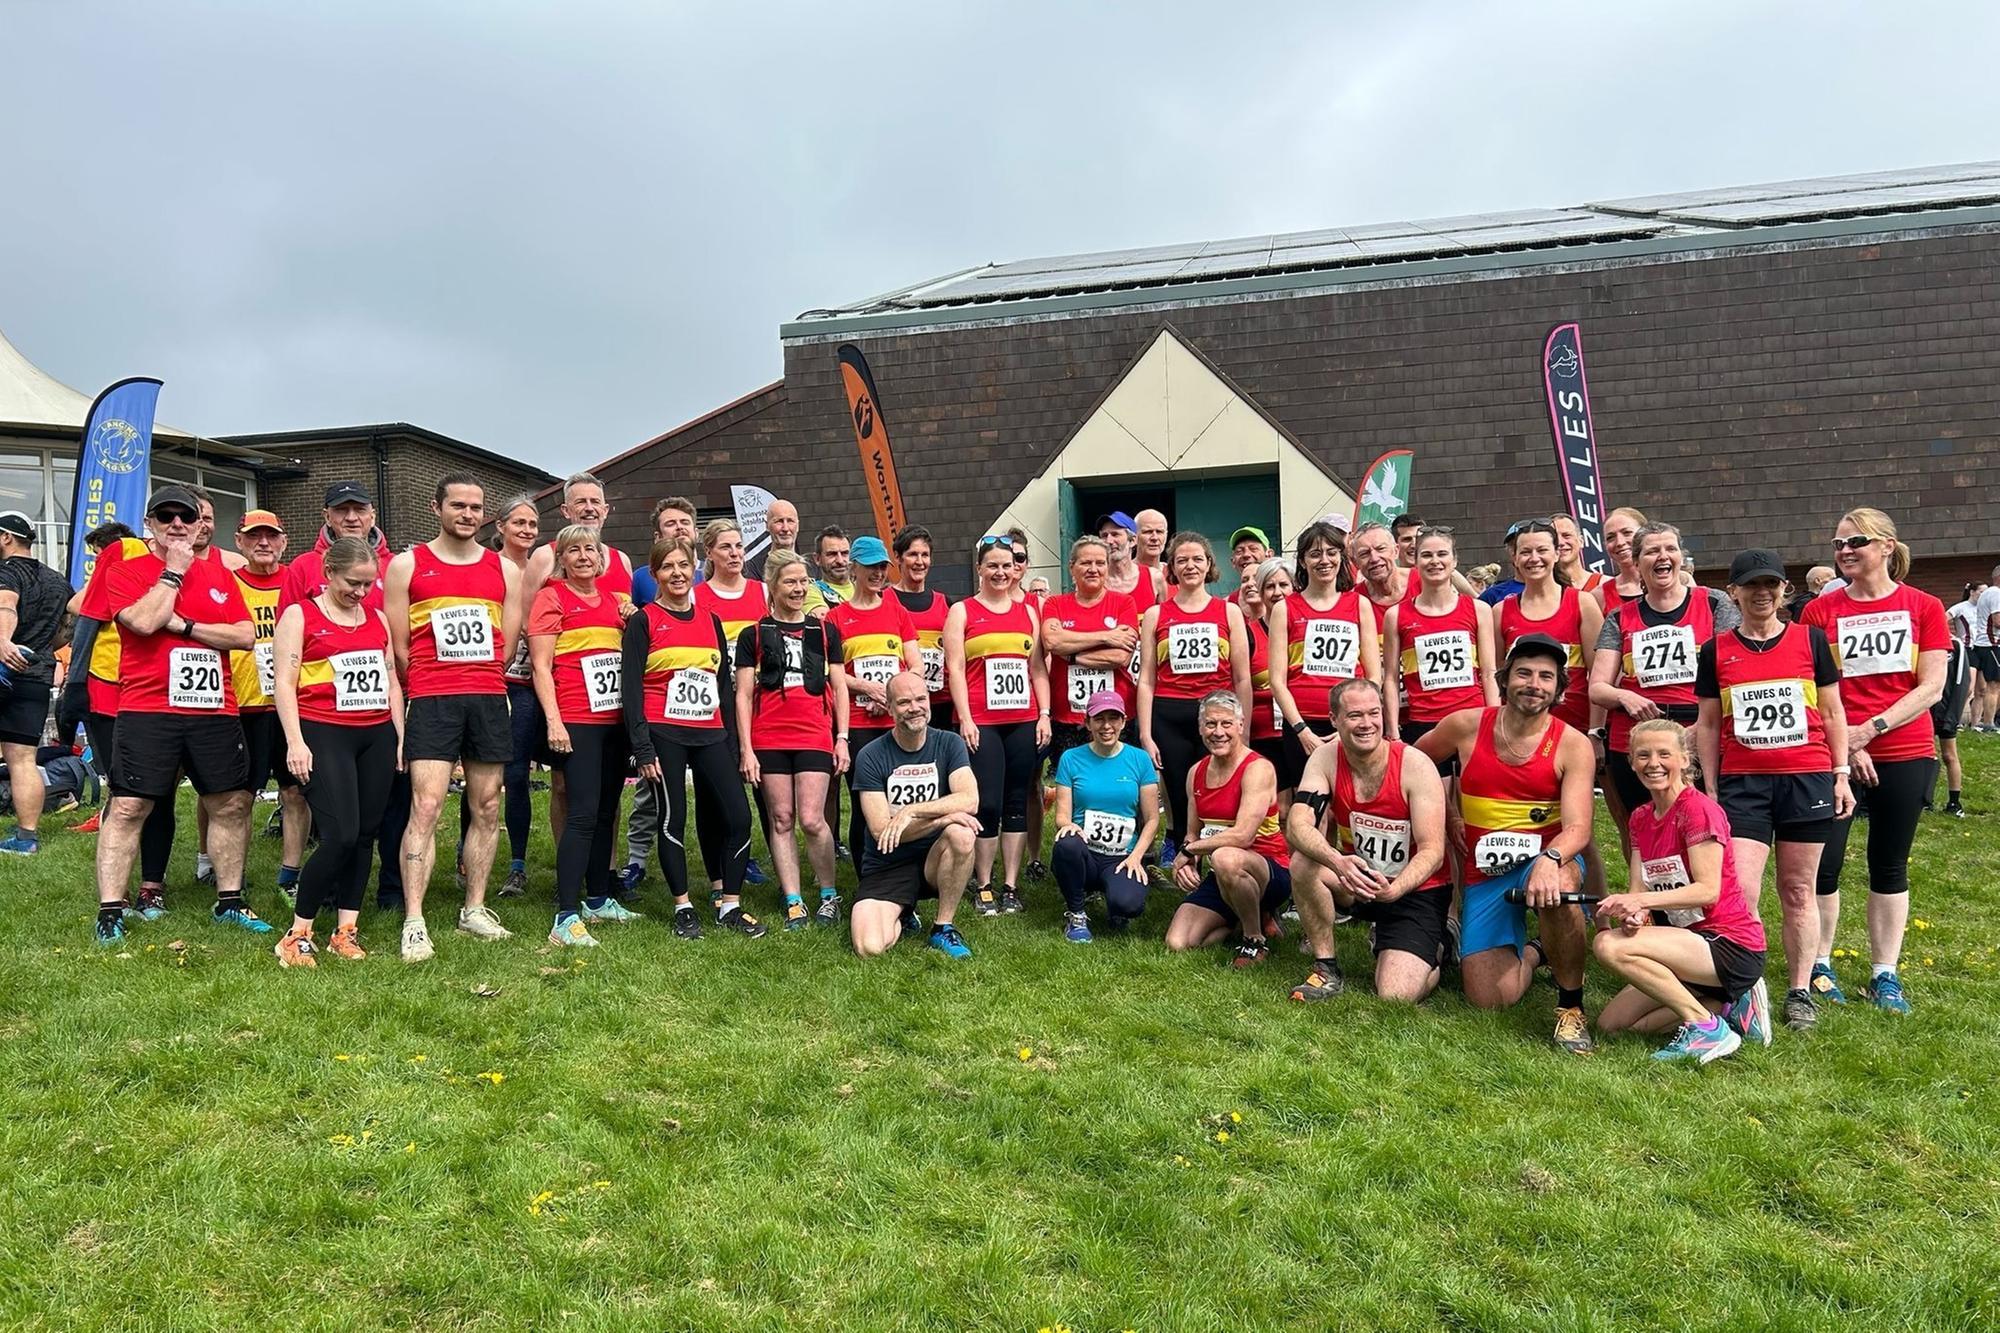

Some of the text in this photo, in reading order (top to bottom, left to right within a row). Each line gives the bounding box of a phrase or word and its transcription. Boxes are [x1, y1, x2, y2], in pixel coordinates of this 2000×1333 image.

[84, 478, 103, 557] EGLES
[440, 608, 480, 620] LEWES AC
[443, 620, 486, 646] 303
[1176, 626, 1211, 636] LEWES AC
[1315, 623, 1352, 635] LEWES AC
[1424, 635, 1463, 648] LEWES AC
[1641, 629, 1670, 642] LEWES
[1176, 637, 1212, 660] 283
[1311, 636, 1353, 662] 307
[1842, 628, 1908, 660] 2407
[180, 652, 208, 664] LEWES
[441, 650, 465, 659] EASTER
[479, 649, 491, 657] RUN
[1641, 640, 1687, 671] 274
[341, 655, 379, 667] LEWES AC
[591, 657, 614, 669] LEWES
[862, 659, 893, 669] LEWES AC
[993, 662, 1015, 671] LEWES
[1174, 664, 1193, 672] EASTER
[1193, 662, 1204, 671] FUN
[1425, 648, 1465, 674] 295
[923, 661, 940, 682] 22
[1074, 668, 1096, 677] LEWES
[1306, 664, 1328, 673] EASTER
[179, 666, 221, 692] 320
[342, 669, 384, 694] 282
[1424, 678, 1446, 687] EASTER
[1446, 676, 1459, 684] FUN
[1640, 670, 1695, 684] EASTER FUN RUN
[993, 674, 1024, 695] 300
[173, 695, 199, 704] EASTER
[199, 695, 213, 704] FUN
[675, 682, 712, 706] 306
[1742, 686, 1792, 701] LEWES AC
[341, 698, 365, 707] EASTER
[594, 700, 615, 709] EASTER
[990, 698, 1009, 706] EASTER
[669, 707, 691, 716] EASTER
[1744, 702, 1796, 732] 298
[1741, 733, 1804, 745] EASTER FUN RUN
[894, 767, 934, 777] GOGAR
[890, 782, 937, 806] 2382
[1354, 816, 1405, 832] GOGAR
[1090, 820, 1125, 844] 331
[1354, 831, 1406, 863] 2416
[1486, 837, 1531, 848] LEWES AC
